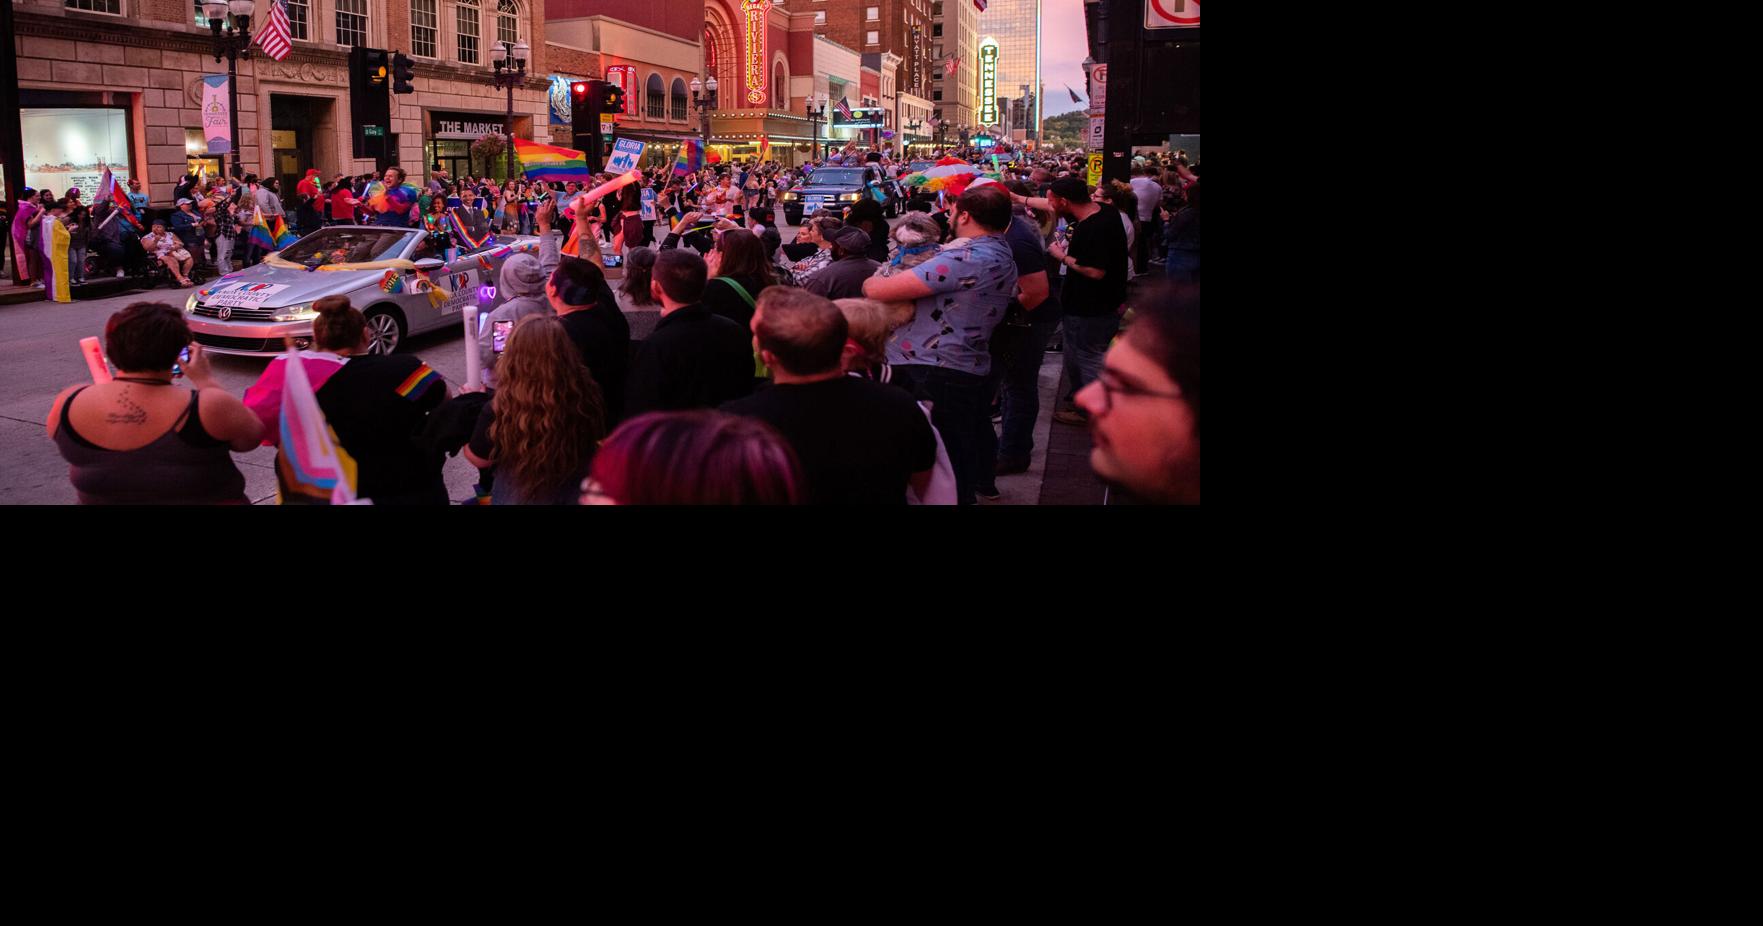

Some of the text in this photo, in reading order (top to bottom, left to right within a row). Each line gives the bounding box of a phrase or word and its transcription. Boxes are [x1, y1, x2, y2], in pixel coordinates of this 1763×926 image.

[750, 11, 759, 86] RIVIERA
[984, 46, 994, 122] TENNESSEE
[205, 116, 228, 128] Fair
[440, 121, 504, 134] THE MARKET
[619, 141, 641, 151] GLORIA
[383, 272, 399, 293] VOTE
[459, 286, 479, 296] COUNTY
[212, 294, 262, 302] DEMOCRATIC
[444, 292, 478, 308] DEMOCRATIC
